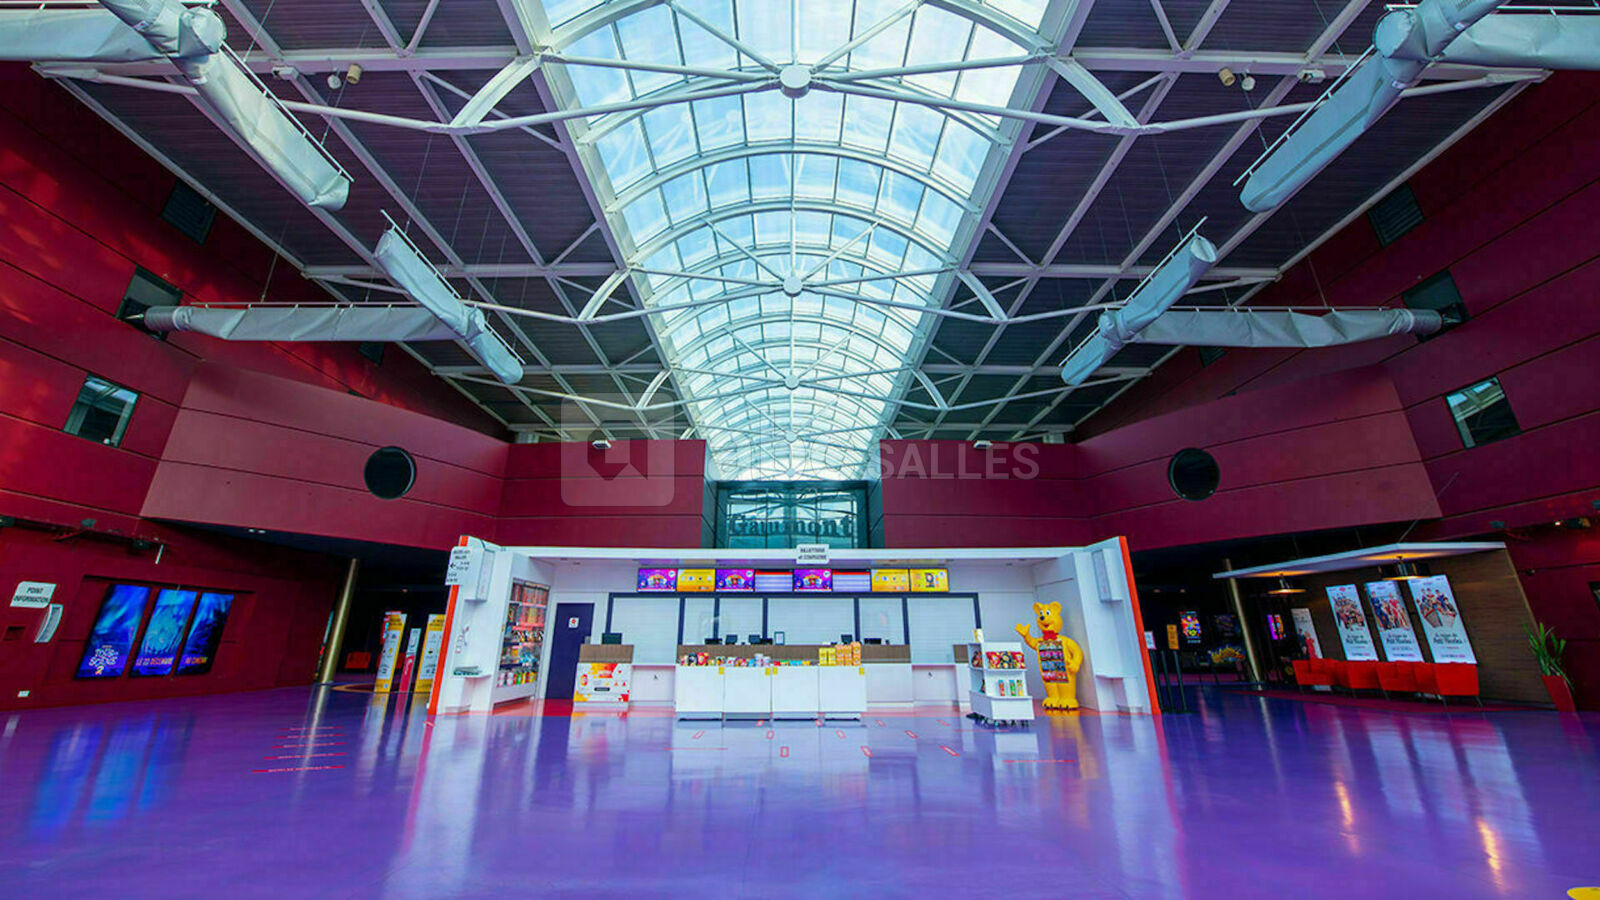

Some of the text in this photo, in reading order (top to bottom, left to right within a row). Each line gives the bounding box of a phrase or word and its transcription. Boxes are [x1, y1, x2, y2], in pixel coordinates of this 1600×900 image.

[728, 513, 853, 537] Gaumont
[26, 586, 44, 594] POINT
[95, 665, 104, 675] 2
